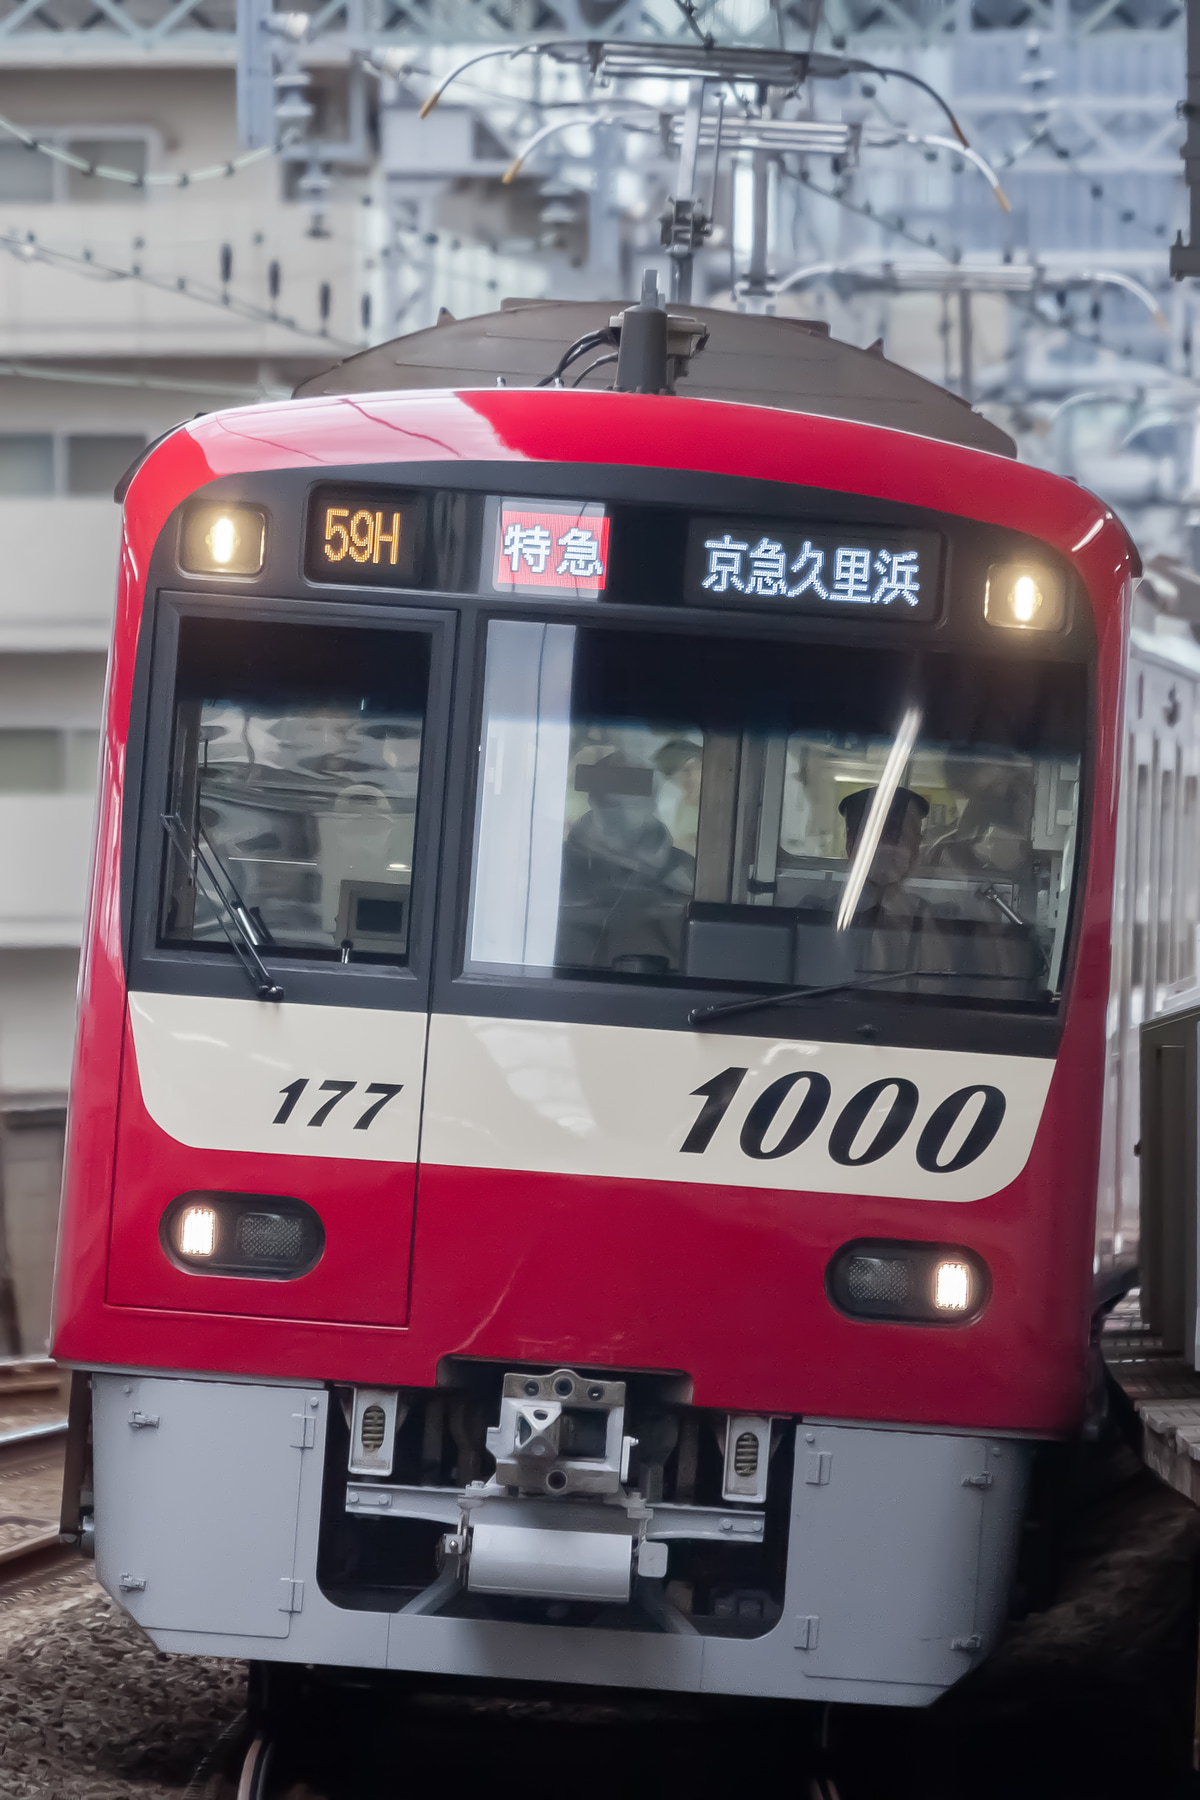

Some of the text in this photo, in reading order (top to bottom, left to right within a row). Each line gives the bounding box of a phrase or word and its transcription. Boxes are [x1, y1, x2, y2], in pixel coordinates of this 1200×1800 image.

[323, 507, 400, 565] 59H
[503, 523, 604, 577] 特急
[701, 534, 920, 607] 京急久里浜
[272, 1078, 403, 1130] 177
[679, 1066, 1007, 1174] 1000
